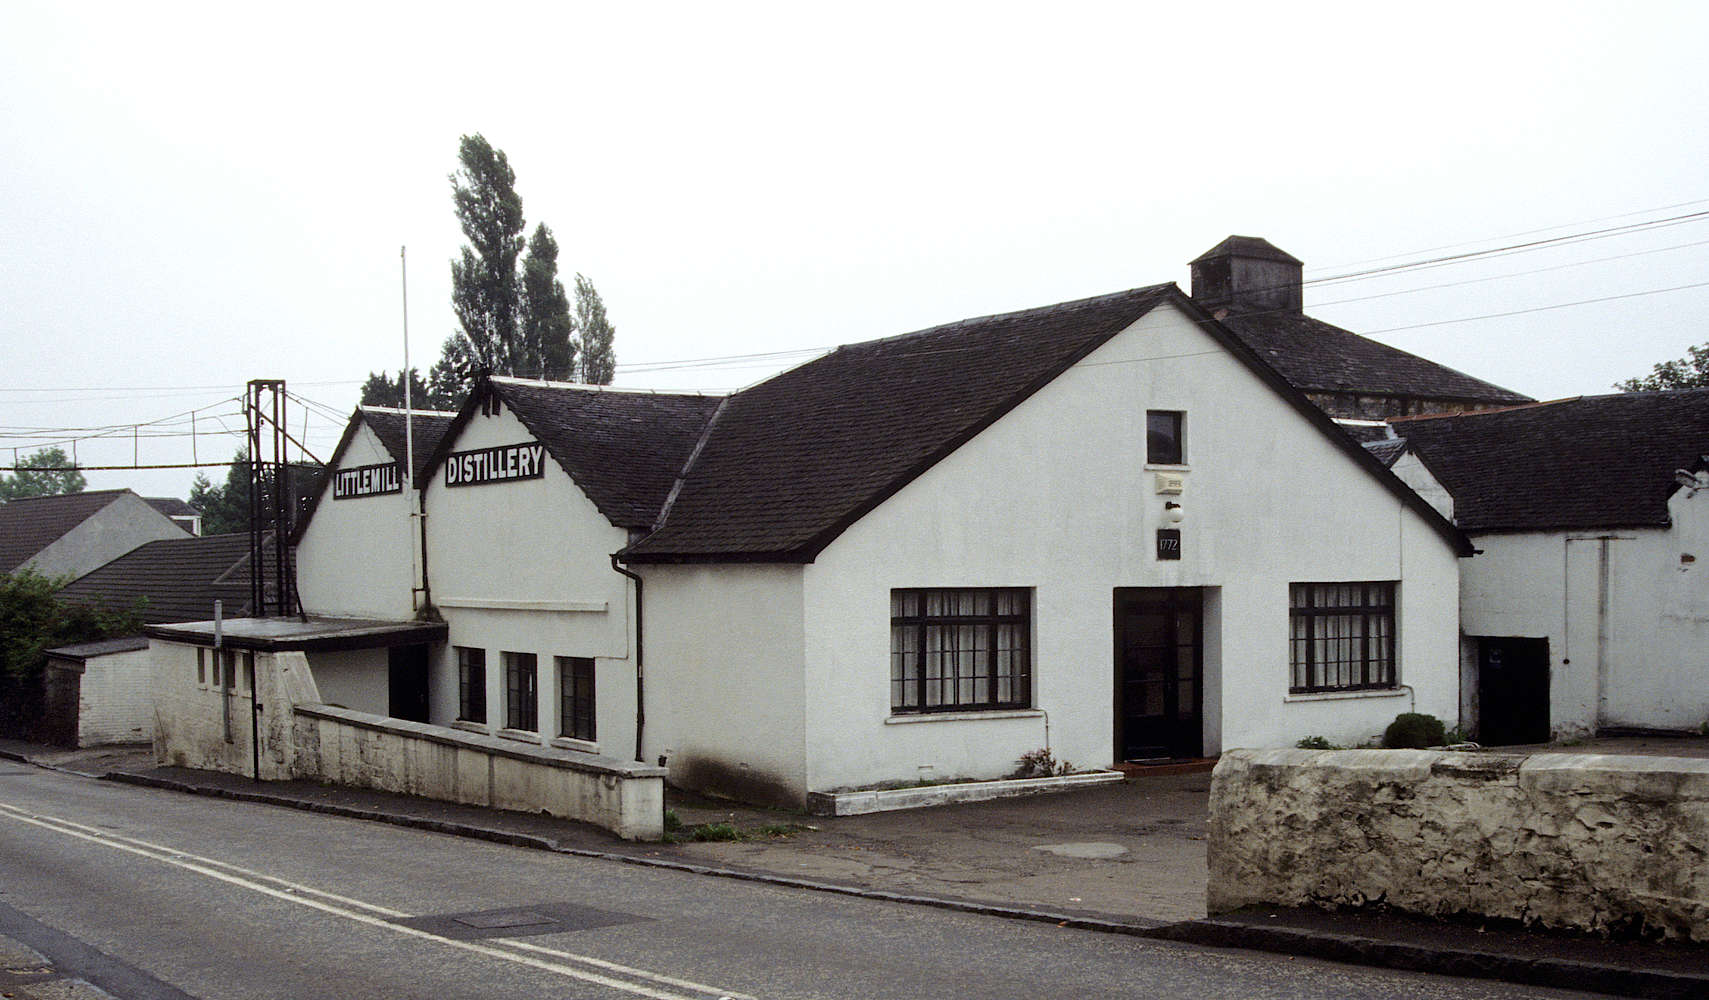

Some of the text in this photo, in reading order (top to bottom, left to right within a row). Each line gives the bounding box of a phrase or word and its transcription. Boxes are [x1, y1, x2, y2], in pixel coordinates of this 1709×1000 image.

[447, 446, 543, 484] DISTILLERY
[335, 466, 399, 497] LITTLEMILL
[1160, 538, 1178, 551] 1772
